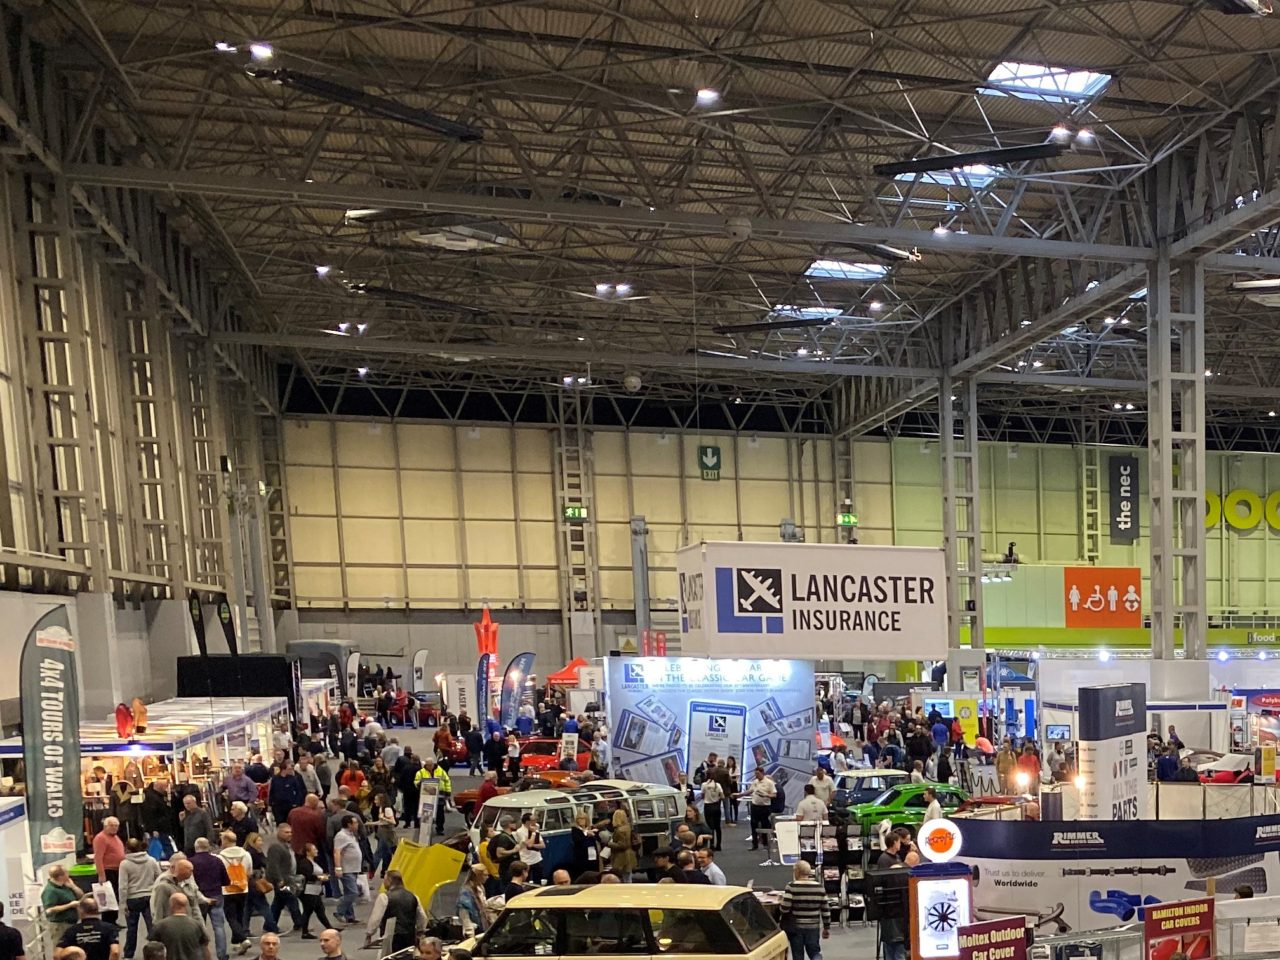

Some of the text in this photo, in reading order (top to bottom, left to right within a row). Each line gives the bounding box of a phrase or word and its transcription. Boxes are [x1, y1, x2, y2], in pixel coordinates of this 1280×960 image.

[1118, 465, 1132, 530] the nec
[790, 573, 935, 605] LANCASTER
[792, 609, 902, 632] INSURANCE
[40, 657, 65, 690] 4x4
[41, 691, 65, 743] TOURS
[43, 745, 65, 768] OF
[45, 768, 65, 818] WALES
[1112, 778, 1138, 796] ALL THE
[1112, 796, 1138, 820] PARTS
[1052, 831, 1105, 845] RIMMER
[984, 868, 1002, 877] Trust
[1012, 869, 1020, 877] to
[994, 879, 1038, 888] Worldwide
[1152, 903, 1209, 920] HAMILTON INDOOR
[1161, 916, 1200, 930] CAR COVERS
[959, 927, 1025, 949] Moltex Outdoor
[989, 946, 1015, 960] Cover
